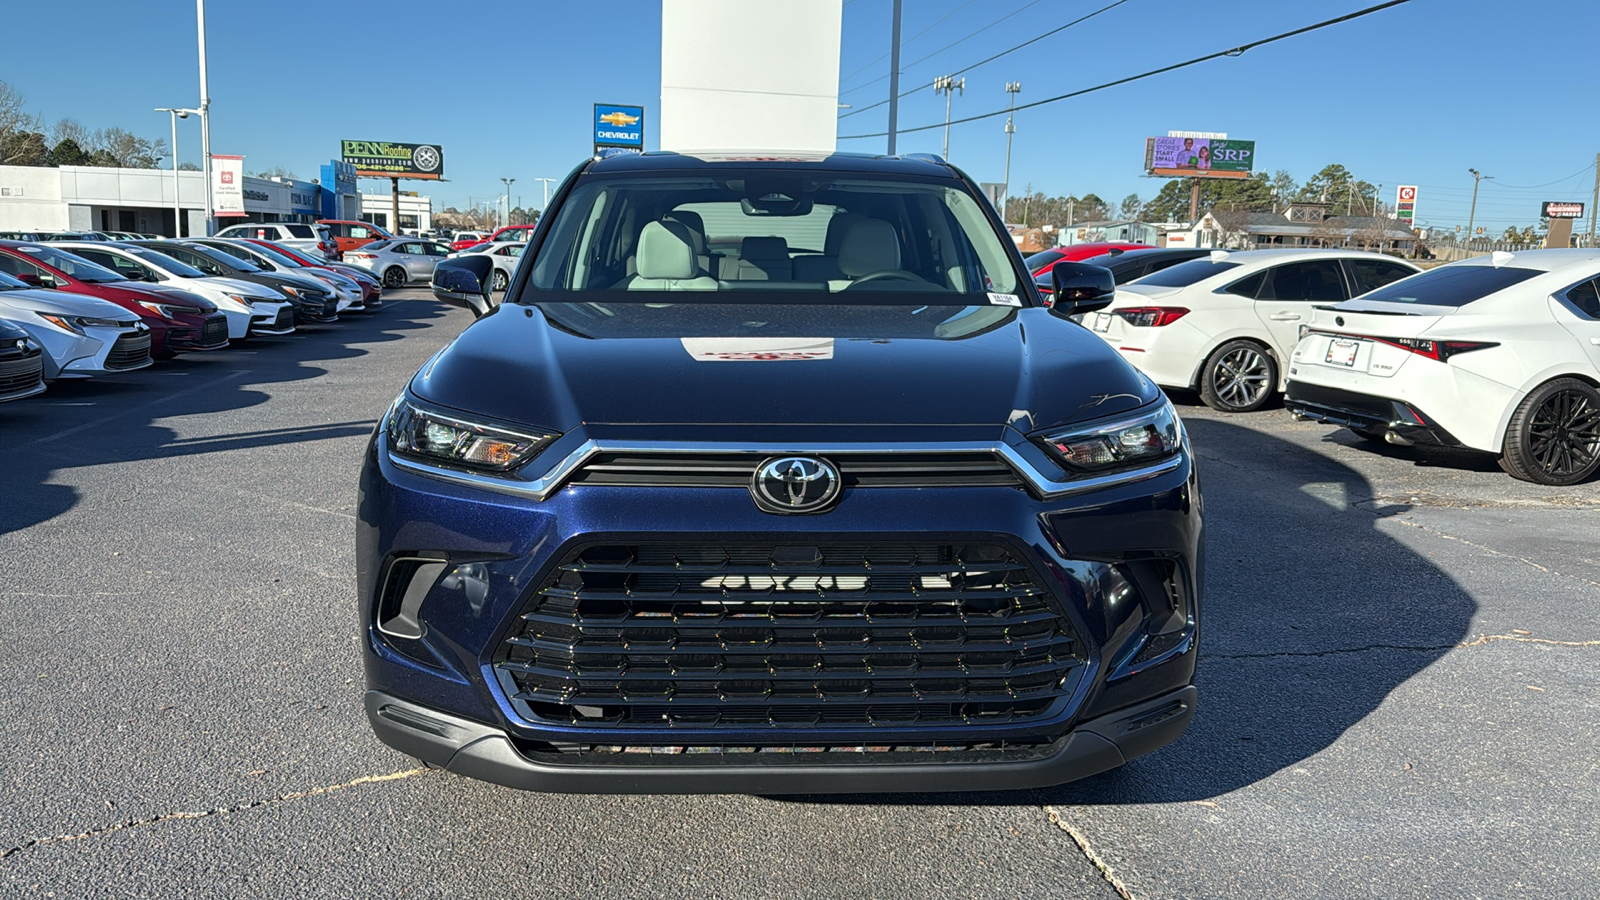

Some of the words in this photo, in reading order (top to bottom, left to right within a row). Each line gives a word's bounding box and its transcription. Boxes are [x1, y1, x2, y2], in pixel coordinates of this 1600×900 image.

[597, 131, 639, 140] CHEVROLET
[343, 141, 388, 156] PENN
[384, 145, 412, 159] Roofing
[1212, 149, 1250, 160] SRP
